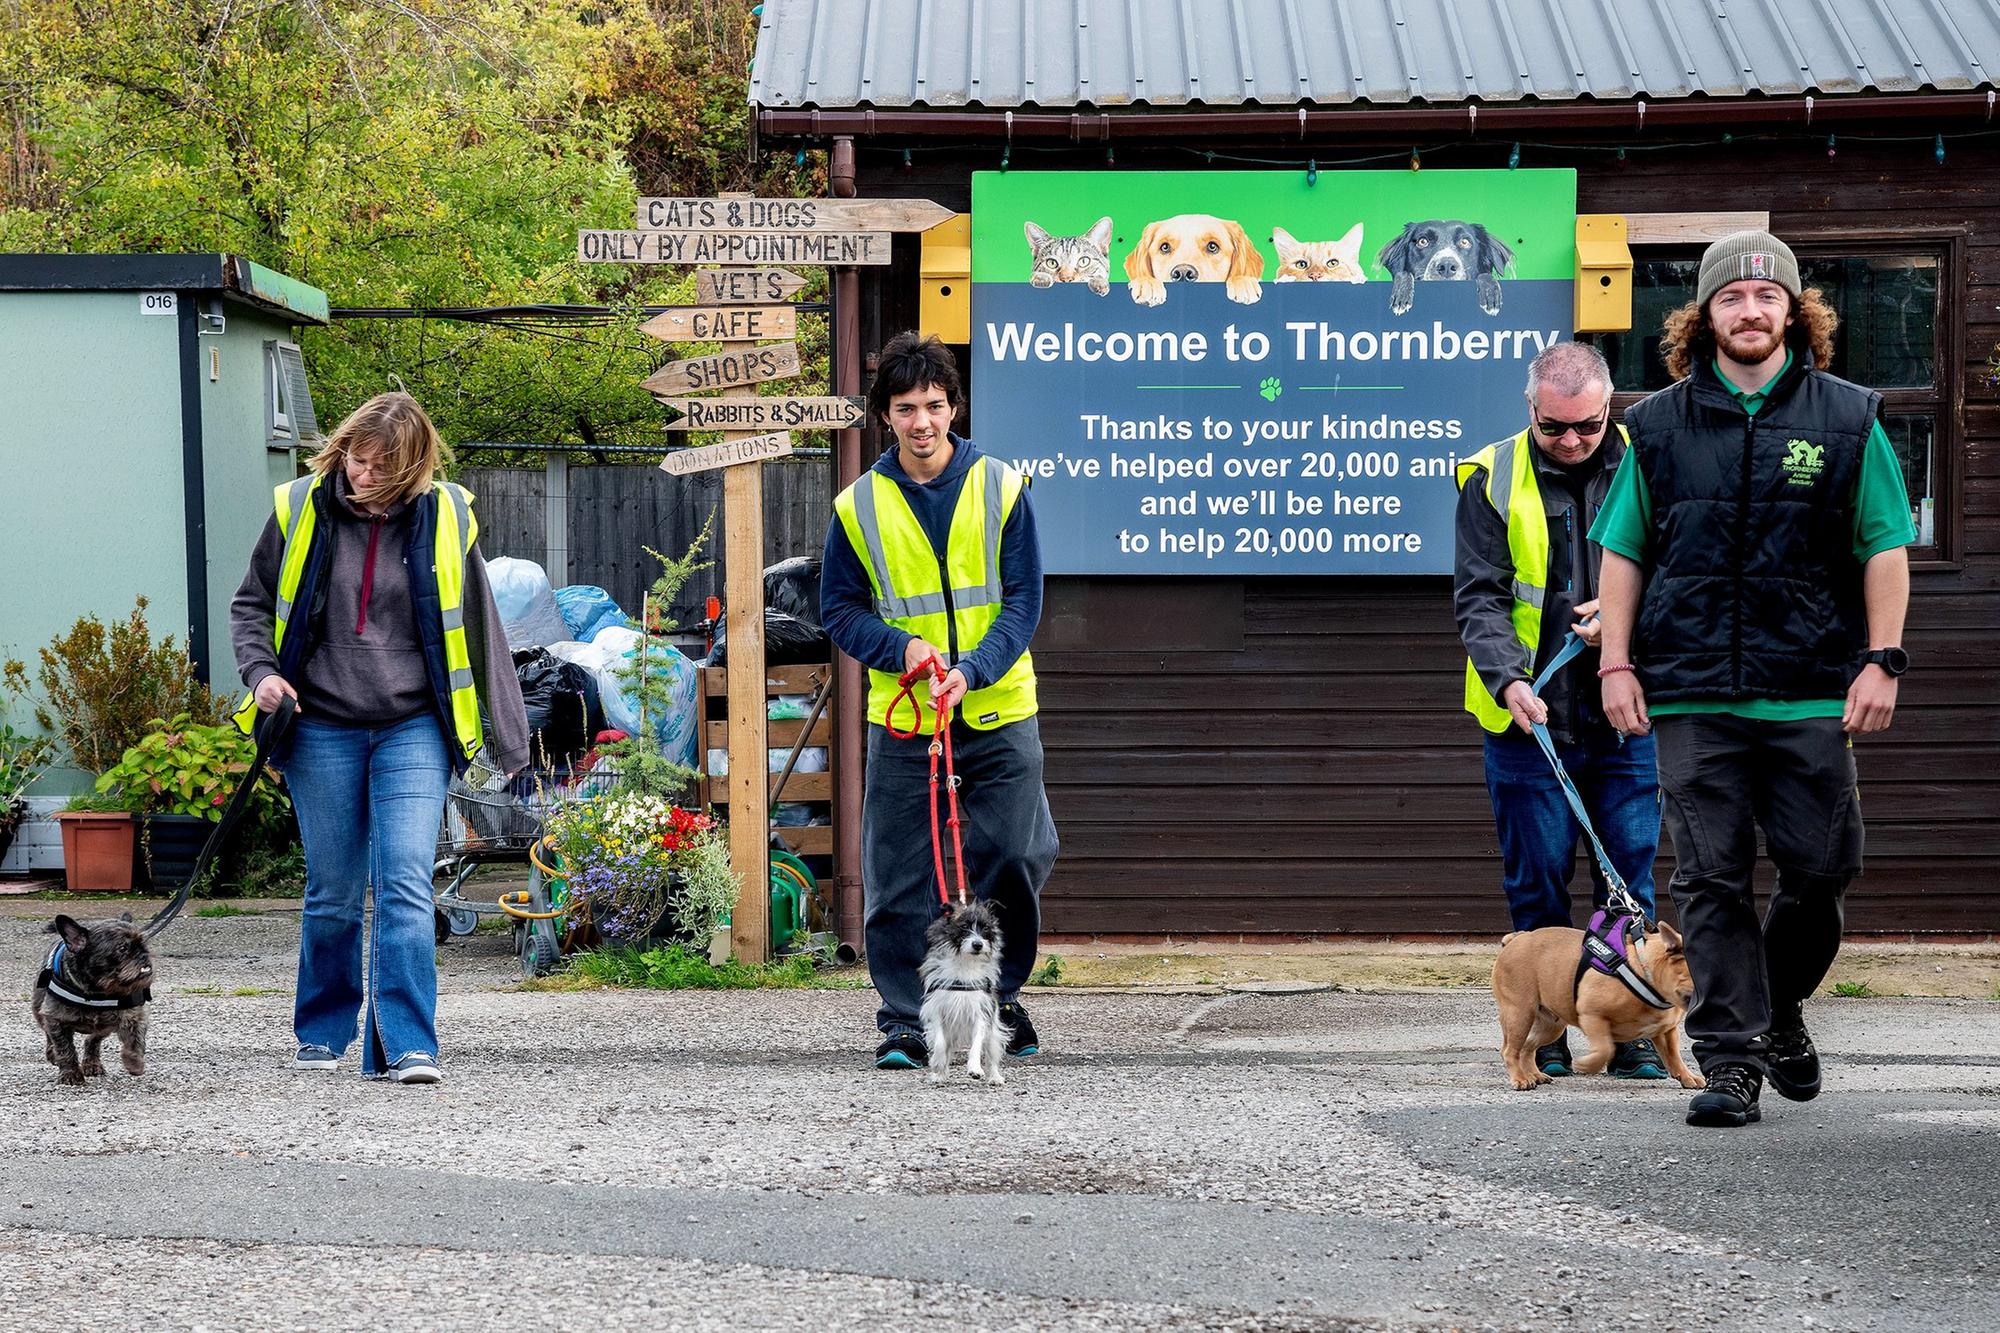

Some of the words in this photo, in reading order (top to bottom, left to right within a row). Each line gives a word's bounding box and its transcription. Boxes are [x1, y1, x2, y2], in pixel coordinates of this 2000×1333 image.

[648, 200, 716, 228] CATS
[727, 201, 745, 228] &
[749, 201, 817, 228] DOGS
[583, 233, 647, 260] ONLY
[657, 234, 687, 261] BY
[694, 234, 874, 262] APPOINTMENT
[710, 272, 783, 300] VETS
[146, 295, 172, 309] 016
[692, 311, 763, 338] CAFE
[986, 322, 1208, 362] Welcome
[1223, 323, 1270, 361] to
[1285, 321, 1560, 361] Thornberry
[685, 350, 777, 389] SHOPS
[1081, 415, 1193, 440] Thanks
[1202, 415, 1233, 440] to
[1242, 419, 1313, 446] your
[1322, 414, 1462, 439] kindness
[673, 436, 780, 472] DONATIONS
[1111, 452, 1213, 483] helped
[1223, 457, 1292, 478] over
[1300, 452, 1399, 482] 20,000
[1140, 490, 1196, 515] and
[1287, 490, 1323, 515] be
[1334, 490, 1401, 515] here
[1119, 529, 1150, 553] to
[1160, 528, 1225, 560] help
[1234, 528, 1333, 558] 20,000
[1343, 533, 1422, 553] more
